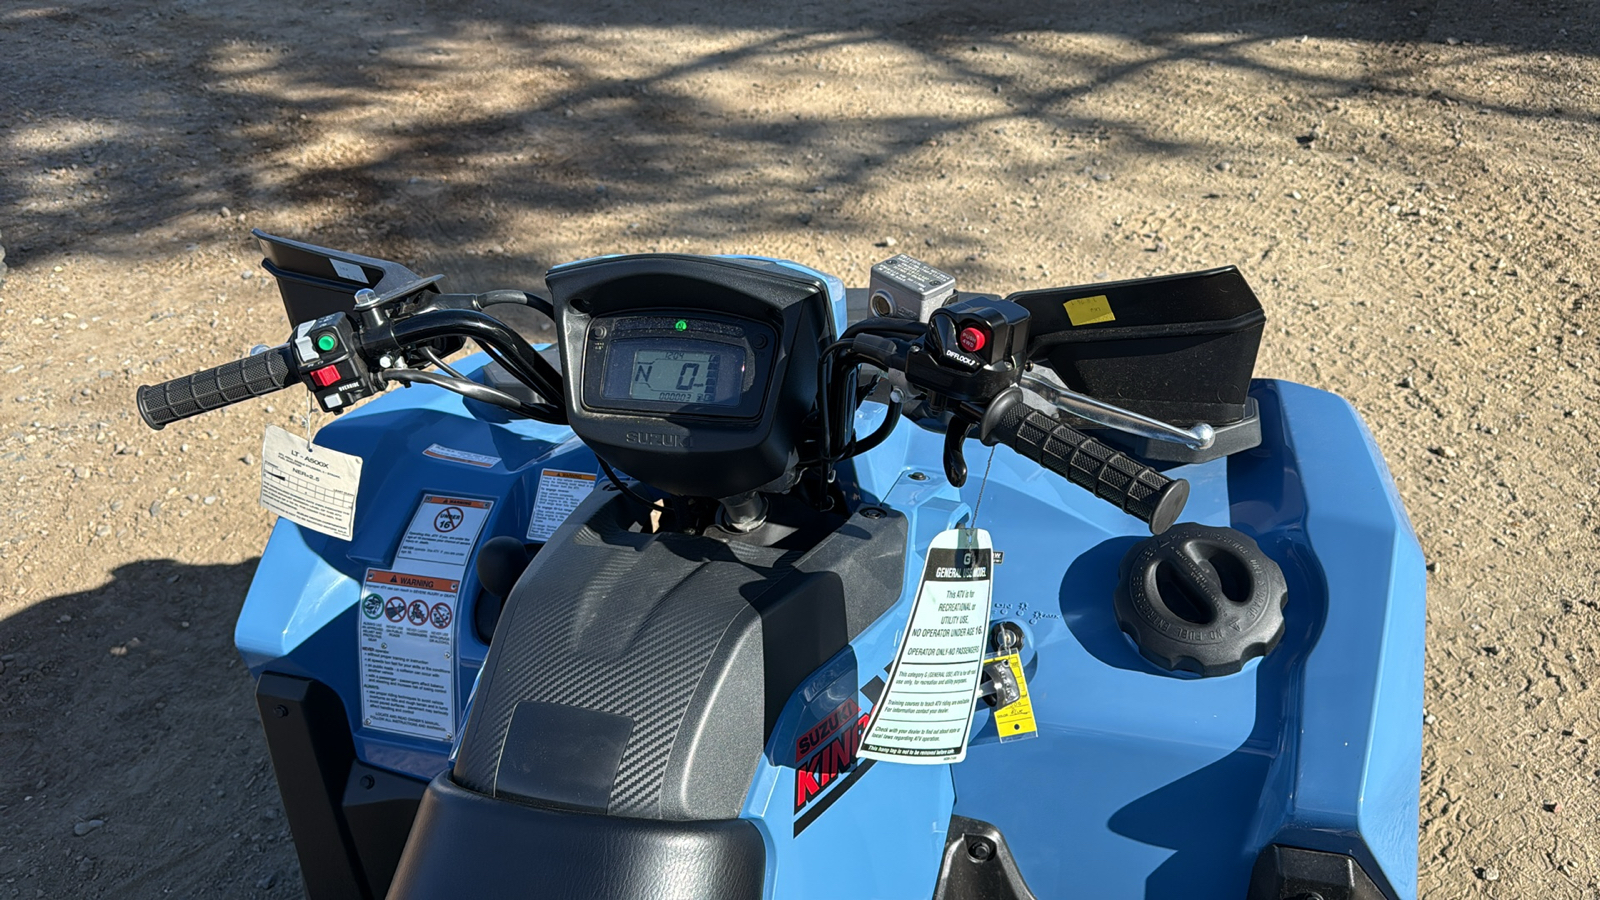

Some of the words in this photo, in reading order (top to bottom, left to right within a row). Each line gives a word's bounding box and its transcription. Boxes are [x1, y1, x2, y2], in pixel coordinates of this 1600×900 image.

[962, 332, 976, 343] PUSH
[962, 339, 974, 348] 4WD
[635, 365, 652, 383] N
[676, 363, 700, 390] 0
[626, 432, 694, 448] SUZUKI
[964, 554, 971, 565] G
[936, 567, 961, 578] GENERAL
[973, 567, 986, 577] MODEL
[401, 577, 434, 588] WARNING
[947, 590, 956, 598] This
[938, 603, 971, 612] RECREATIONAL
[941, 616, 959, 624] UTILITY
[912, 628, 921, 637] NO
[922, 629, 950, 637] OPERATOR
[951, 628, 966, 637] UNDER
[967, 627, 975, 636] AGE
[908, 648, 935, 656] OPERATOR
[799, 702, 853, 754] SUZUKI
